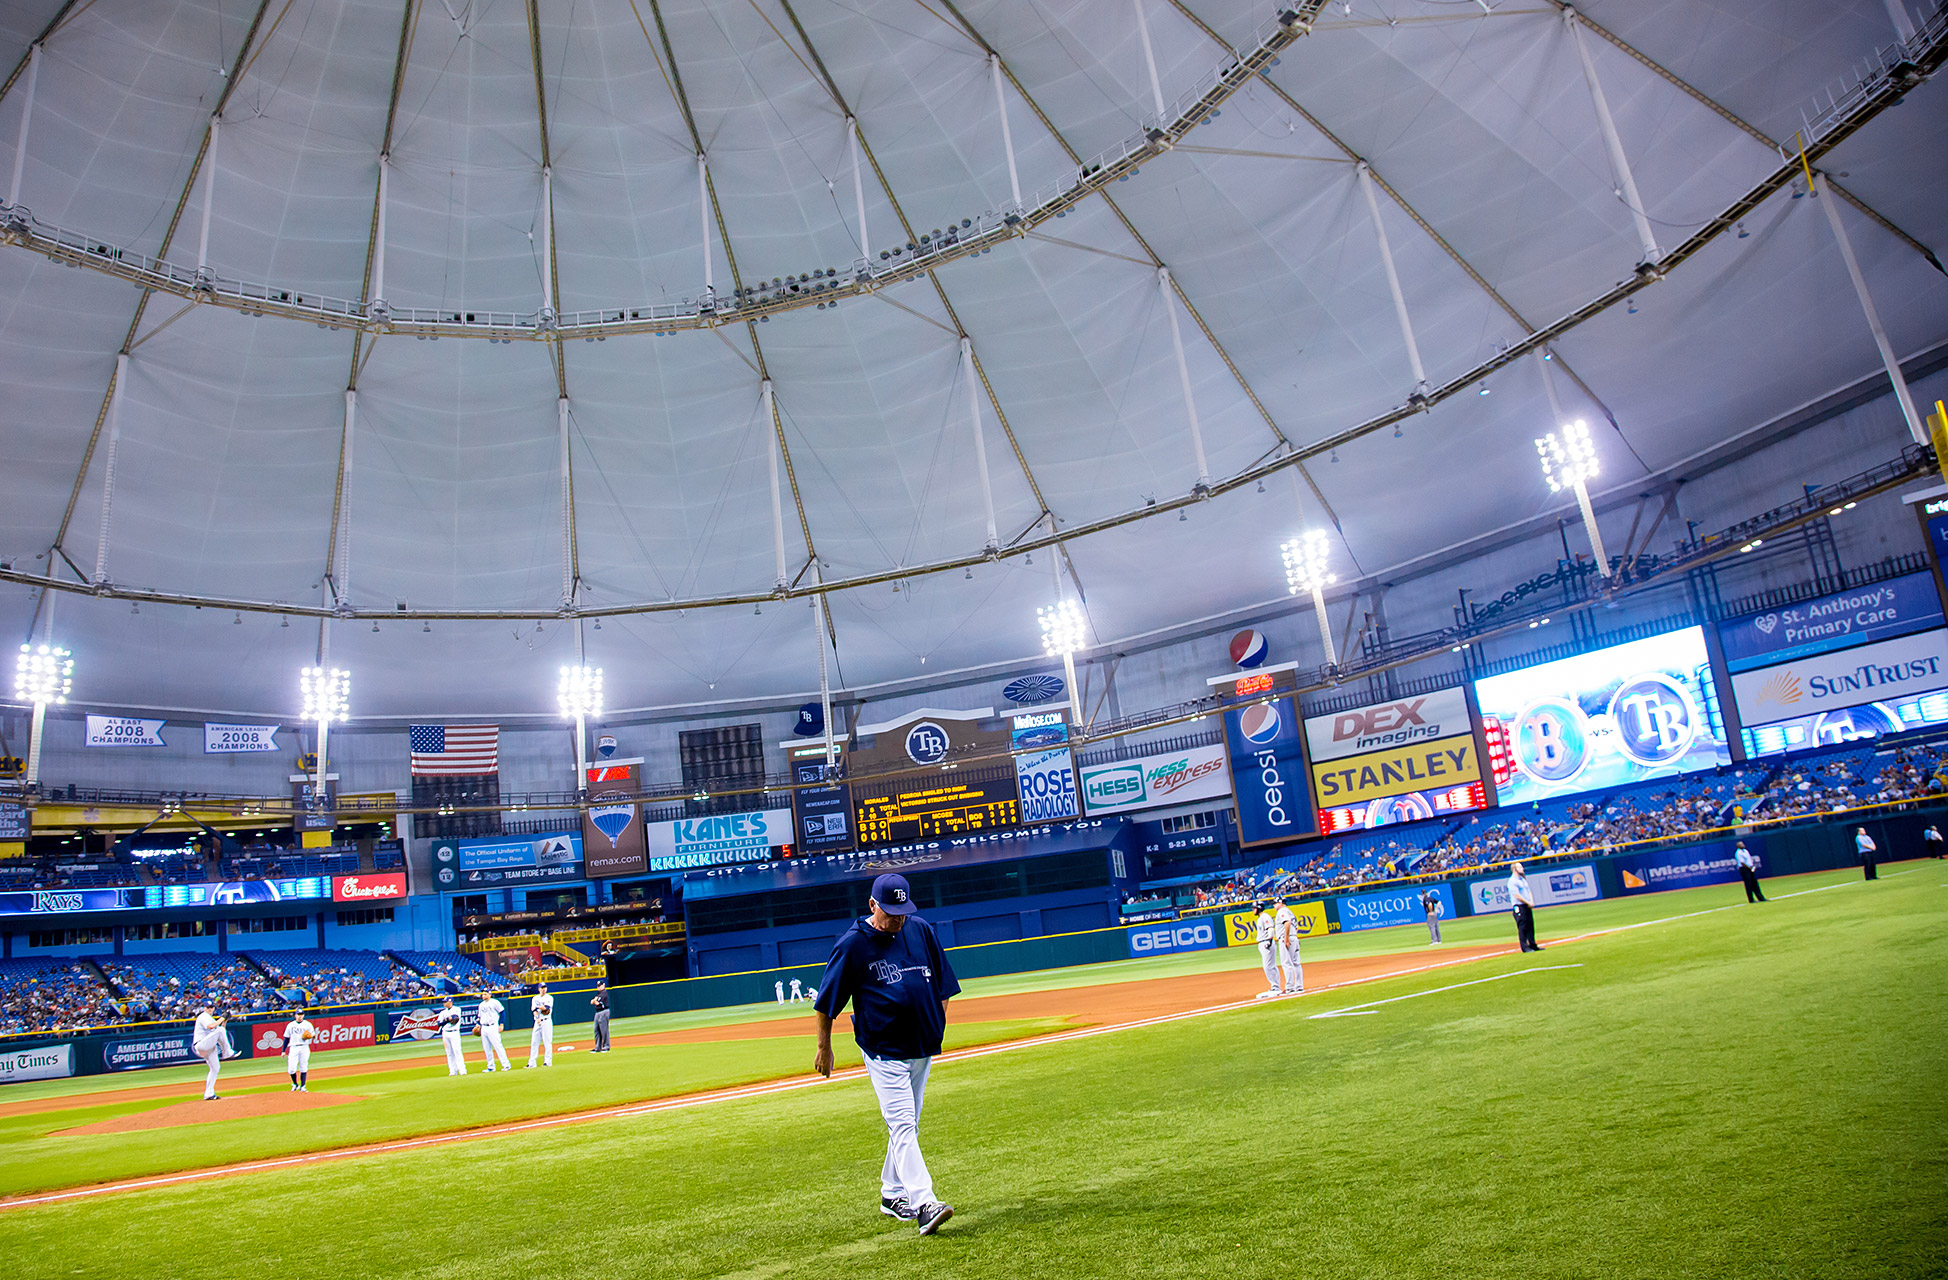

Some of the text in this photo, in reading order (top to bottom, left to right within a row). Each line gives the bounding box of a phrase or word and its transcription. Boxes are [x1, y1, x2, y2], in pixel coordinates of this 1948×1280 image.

[1782, 587, 1895, 626] St. Anthony's
[1785, 606, 1896, 643] Primary Care
[801, 711, 812, 722] TB
[1332, 698, 1427, 743] DEX
[1620, 690, 1690, 752] TB
[104, 725, 144, 737] 2008
[222, 732, 260, 743] 2008
[1356, 723, 1440, 749] imaging
[92, 735, 154, 745] CHAMPIONS
[913, 730, 944, 757] TB
[1145, 758, 1189, 782] HESS
[1320, 746, 1468, 796] STANLEY
[1019, 768, 1076, 799] ROSE
[1089, 780, 1140, 798] HESS
[1254, 749, 1292, 826] pepsi
[0, 809, 26, 819] eard
[879, 804, 898, 812] TOTAL
[1022, 793, 1076, 821] RADIOLOGY
[673, 812, 768, 844] KANE'S
[828, 823, 843, 831] ERA
[859, 823, 867, 832] B
[869, 822, 876, 830] S
[945, 818, 965, 826] TOTAL
[1001, 817, 1006, 825] 4
[0, 827, 25, 837] uzz?
[860, 830, 887, 843] 0 0 1
[679, 836, 763, 853] FURNITURE
[707, 866, 746, 877] CITY
[790, 858, 816, 866] ST.
[826, 842, 940, 861] PETERSBURG
[951, 828, 1051, 846] WELCOMES
[1063, 820, 1102, 831] YOU
[1146, 844, 1159, 852] K-2
[541, 851, 569, 861] Majestic
[590, 855, 642, 867] remax.com
[504, 866, 575, 879] TEAM STORE BASE LINE
[1649, 855, 1761, 878] MicroLumn
[894, 888, 907, 902] TB
[1347, 895, 1413, 921] Sagicor
[1328, 921, 1341, 931] 370
[1131, 924, 1213, 952] GEICO
[868, 959, 902, 985] TB
[460, 1015, 477, 1025] ALK
[311, 1023, 372, 1045] teFarm
[376, 1033, 390, 1042] 370
[116, 1039, 184, 1054] AMERICA'S NEW
[0, 1053, 59, 1074] ay Times
[112, 1047, 188, 1064] SPORTS NETWORK
